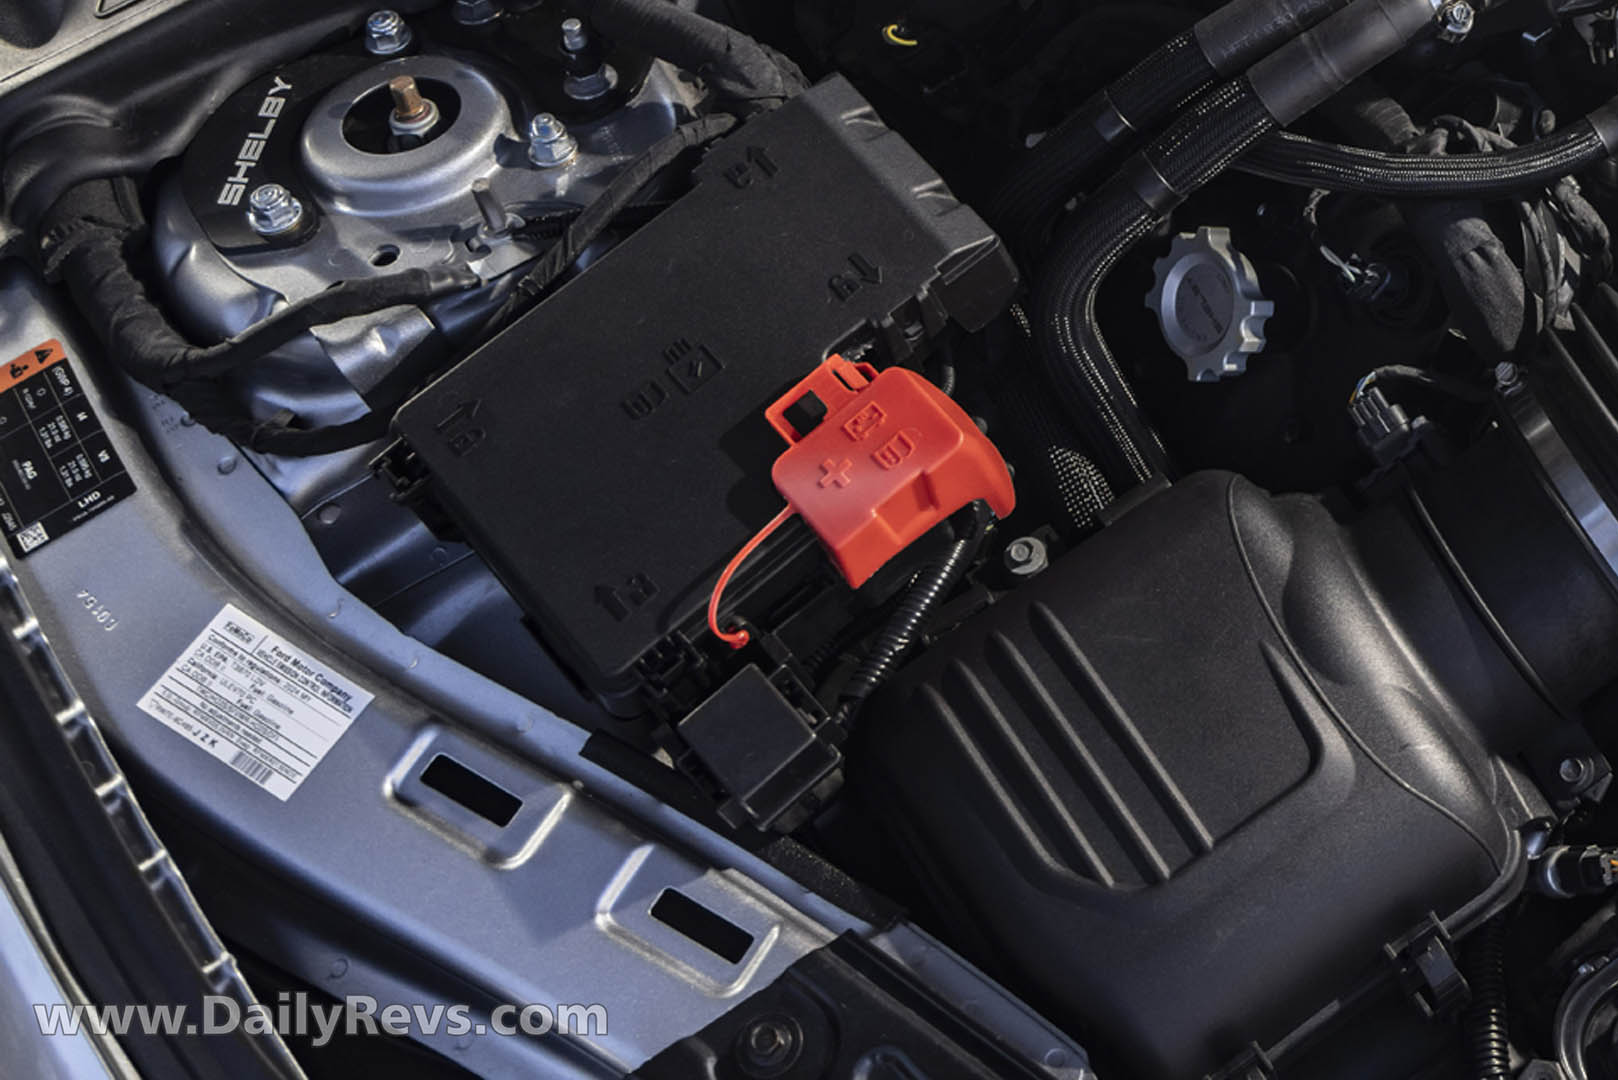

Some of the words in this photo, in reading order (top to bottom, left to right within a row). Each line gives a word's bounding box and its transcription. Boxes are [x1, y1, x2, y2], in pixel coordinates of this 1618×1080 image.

[218, 75, 292, 206] SHELBY
[21, 459, 39, 481] PAG
[77, 490, 102, 509] LHD
[269, 645, 293, 663] Ford
[289, 657, 317, 678] Motor
[311, 672, 355, 703] Company
